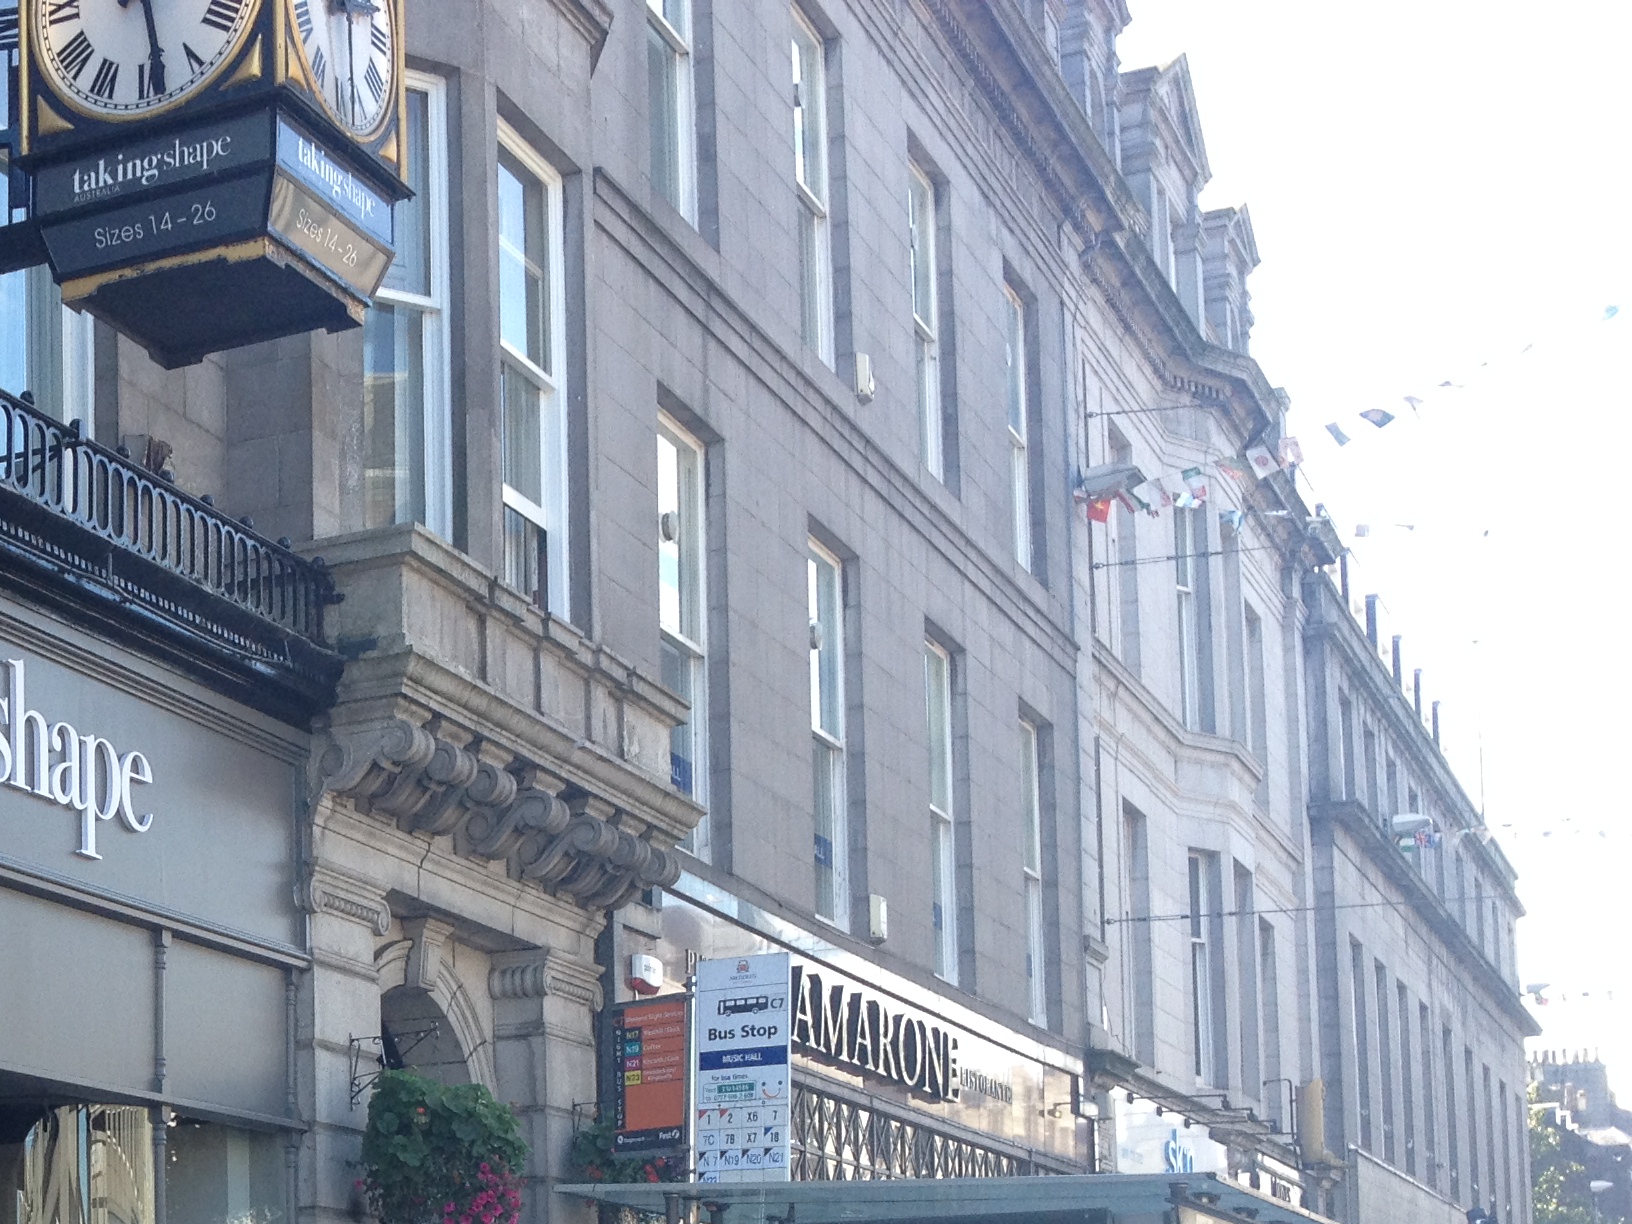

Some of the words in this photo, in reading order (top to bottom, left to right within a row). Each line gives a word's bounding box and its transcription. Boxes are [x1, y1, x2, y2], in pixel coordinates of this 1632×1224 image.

[73, 186, 120, 203] AUSTRALIA
[94, 221, 144, 249] Sizes
[149, 211, 173, 235] 14
[191, 200, 217, 226] 26
[296, 208, 322, 242] Sizes
[323, 228, 337, 252] 14
[342, 243, 358, 268] 26
[770, 998, 784, 1009] C7
[626, 1031, 639, 1039] N17
[708, 1028, 735, 1041] Bus
[741, 1024, 778, 1039] Stop
[791, 969, 961, 1103] AMARONE
[625, 1045, 639, 1054] N19
[626, 1060, 639, 1068] N21
[722, 1055, 744, 1063] MUSIC
[745, 1052, 763, 1061] HALL
[728, 1113, 733, 1124] 2
[747, 1111, 758, 1122] X6
[772, 1110, 778, 1121] 7
[703, 1134, 715, 1146] 7C
[726, 1133, 735, 1145] 7B
[747, 1132, 757, 1143] X7
[770, 1131, 779, 1143] 18
[724, 1153, 740, 1166] N19
[746, 1153, 762, 1165] N20
[768, 1152, 784, 1163] N21
